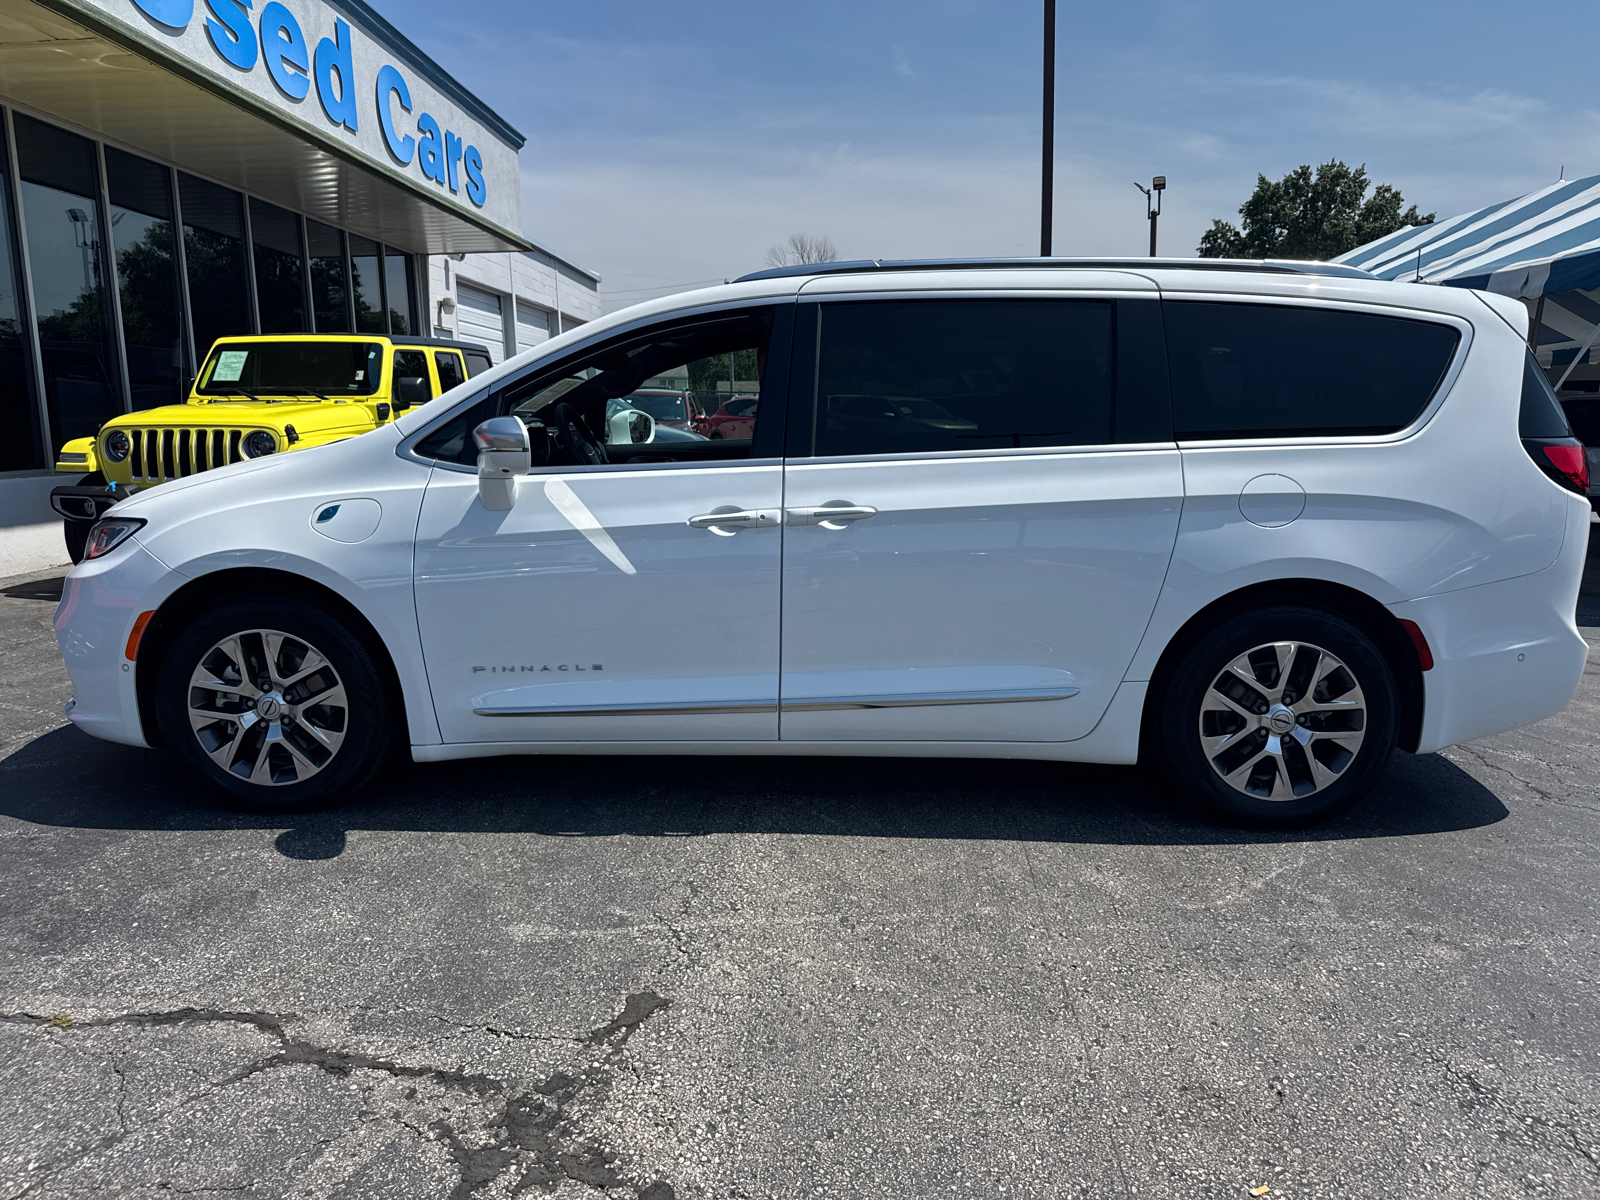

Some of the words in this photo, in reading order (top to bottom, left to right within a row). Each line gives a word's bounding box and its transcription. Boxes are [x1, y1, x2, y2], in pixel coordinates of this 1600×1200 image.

[134, 0, 359, 132] sed
[377, 64, 487, 206] Cars
[472, 663, 604, 674] PINNACLE
